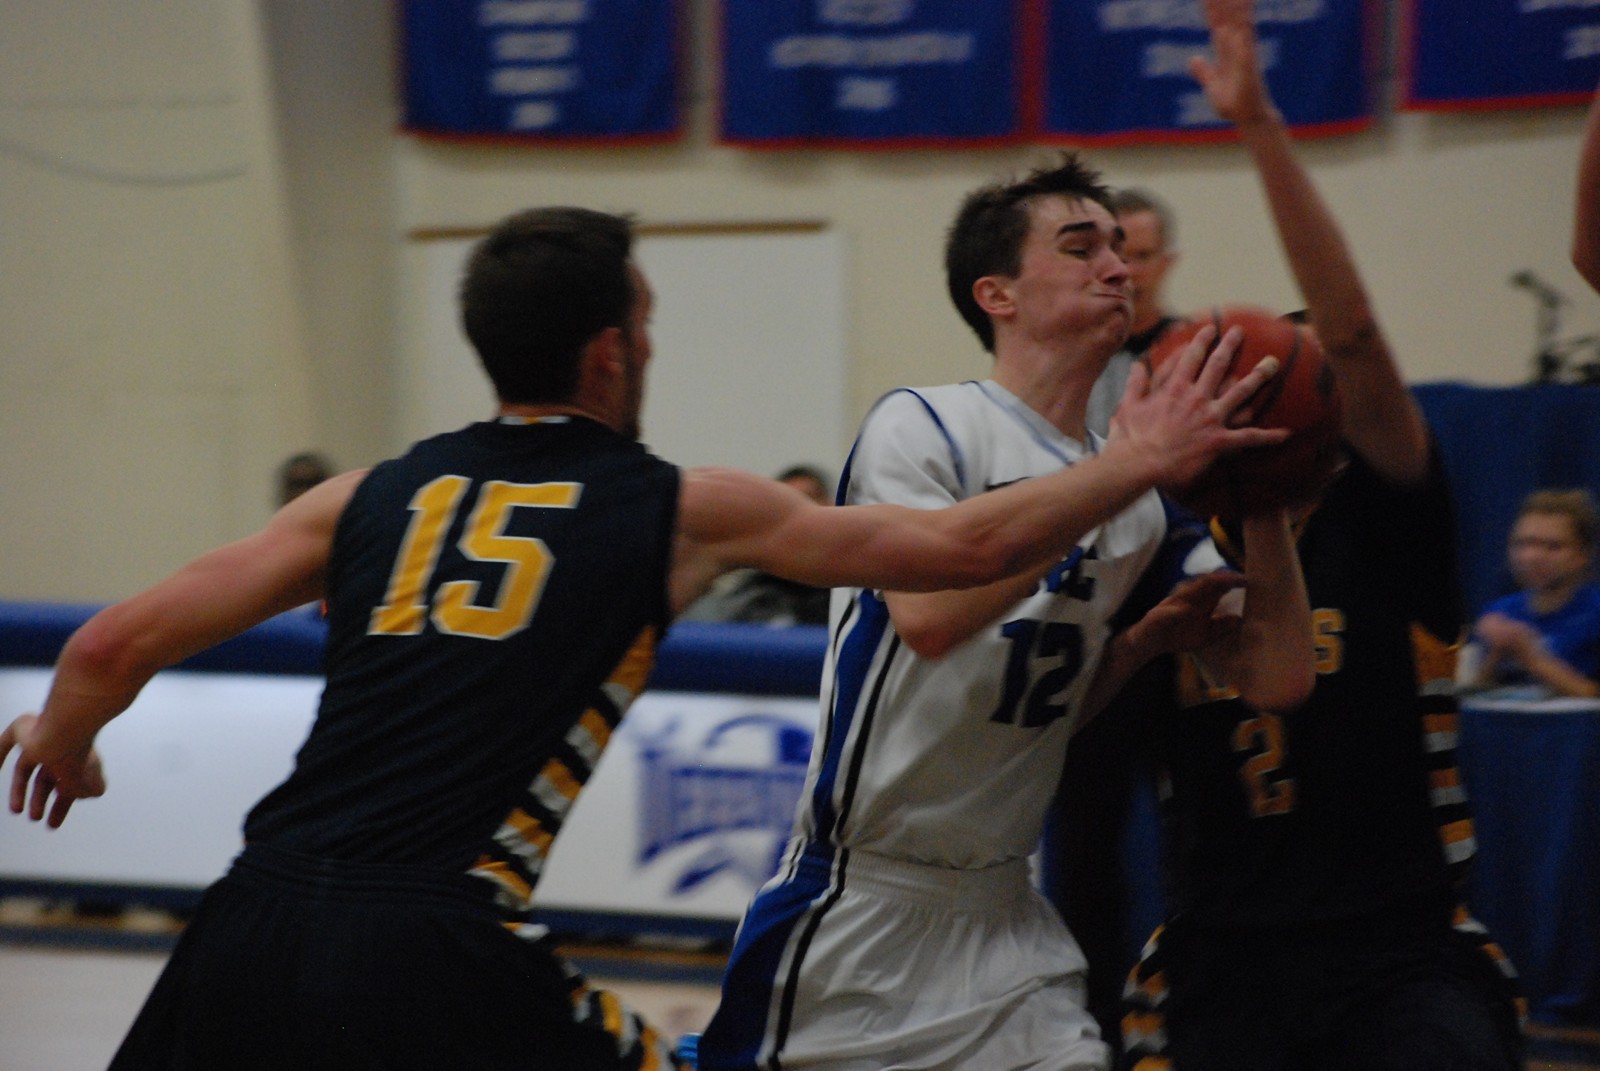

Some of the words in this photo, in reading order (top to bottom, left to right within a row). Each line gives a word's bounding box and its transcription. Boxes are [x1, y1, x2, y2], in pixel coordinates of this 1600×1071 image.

[366, 474, 584, 641] 15
[990, 618, 1083, 727] 12
[1230, 713, 1297, 818] 2
